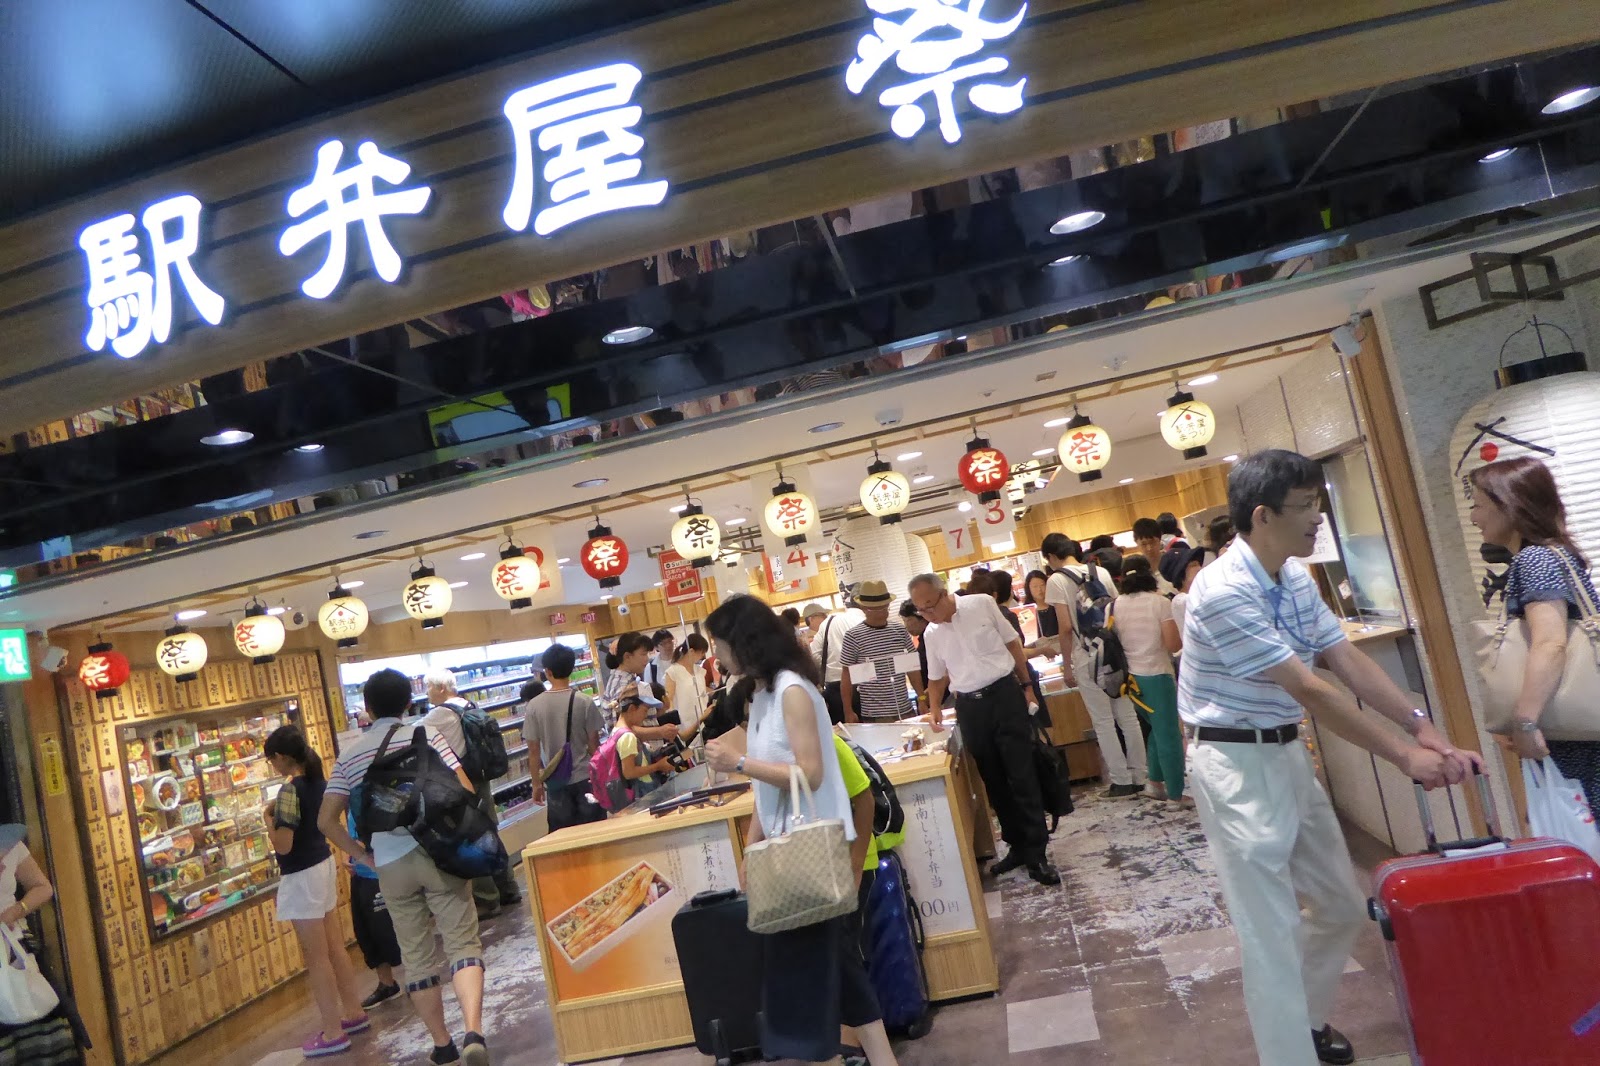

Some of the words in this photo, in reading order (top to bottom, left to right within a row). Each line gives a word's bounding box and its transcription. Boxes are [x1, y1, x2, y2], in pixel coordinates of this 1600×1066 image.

[1069, 431, 1101, 466] 祭
[968, 450, 1002, 485] 祭
[776, 497, 807, 530] 祭
[982, 500, 1005, 525] 3
[684, 517, 715, 549] 祭
[948, 528, 964, 549] 7
[588, 539, 621, 571] 祭
[787, 549, 809, 568] 4
[496, 563, 524, 595] 祭
[406, 583, 433, 613] 祭
[235, 622, 259, 652] 祭
[160, 638, 191, 670] 祭
[79, 655, 110, 687] 祭
